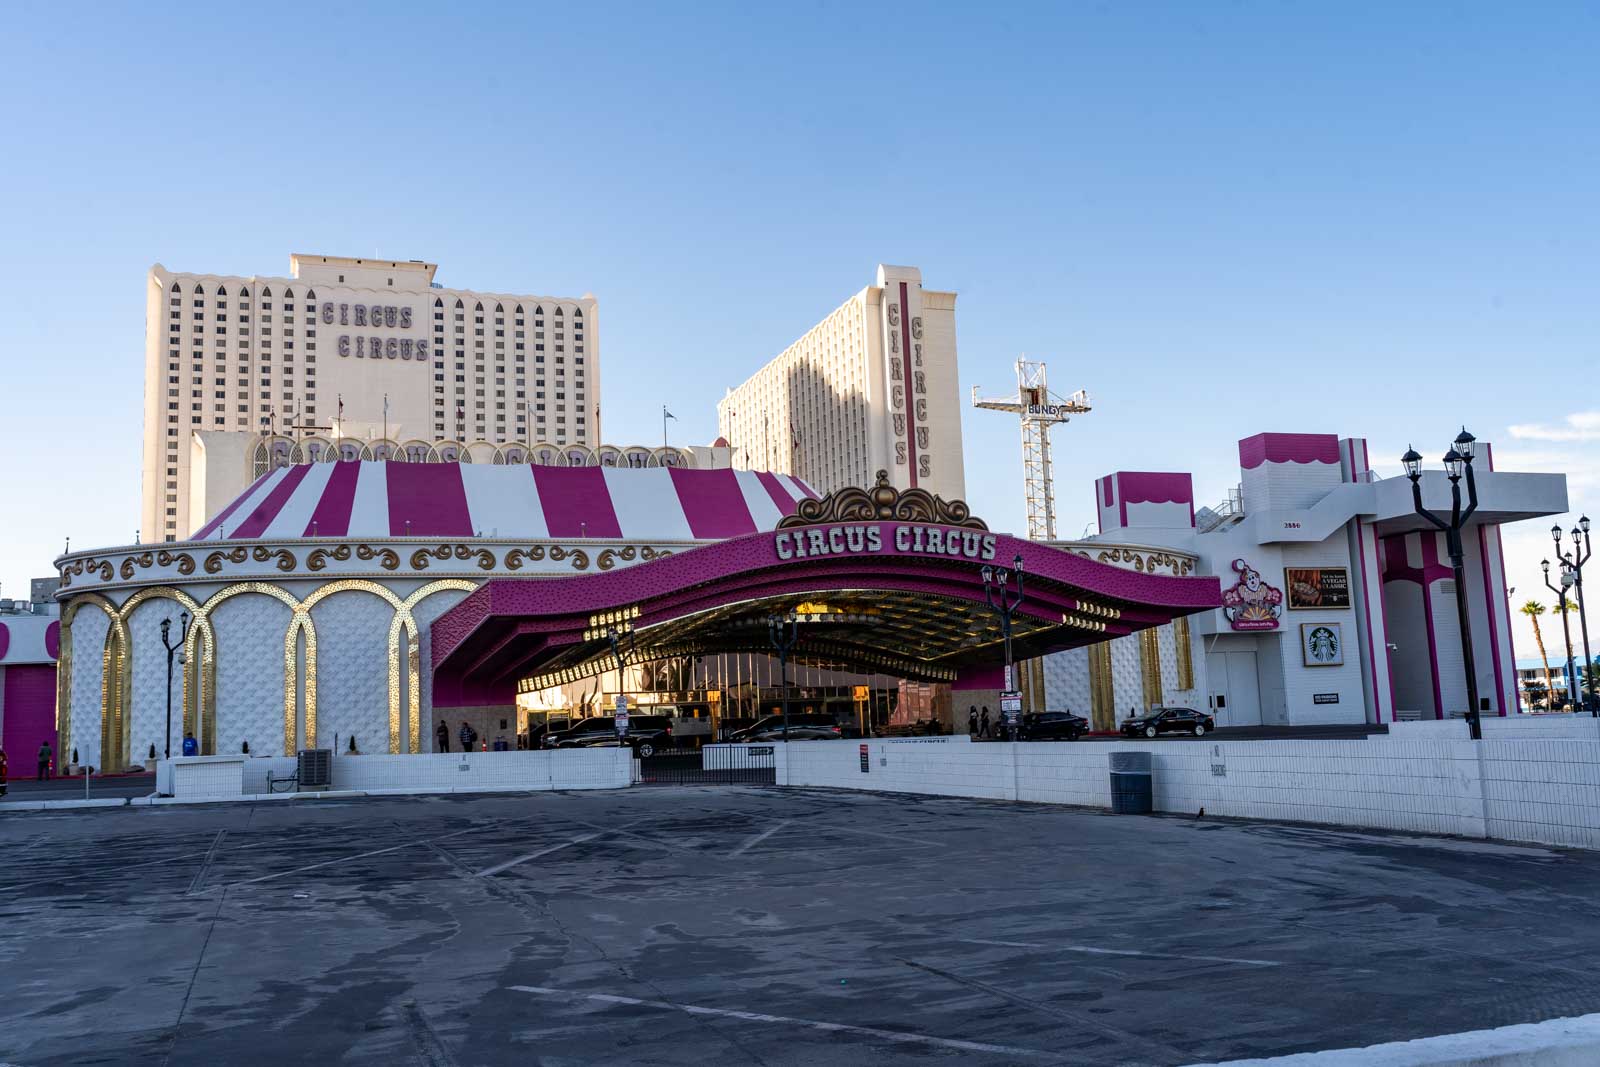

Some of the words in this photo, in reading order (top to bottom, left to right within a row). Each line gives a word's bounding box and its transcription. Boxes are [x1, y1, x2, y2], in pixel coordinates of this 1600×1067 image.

[322, 302, 412, 329] CIRCUS
[338, 335, 428, 361] CIRCUS
[887, 303, 907, 465] CIRCUS
[911, 316, 930, 477] CIRCUS
[1028, 404, 1061, 415] BUNGY
[775, 526, 883, 561] CIRCUS
[895, 526, 997, 561] CIRCUS
